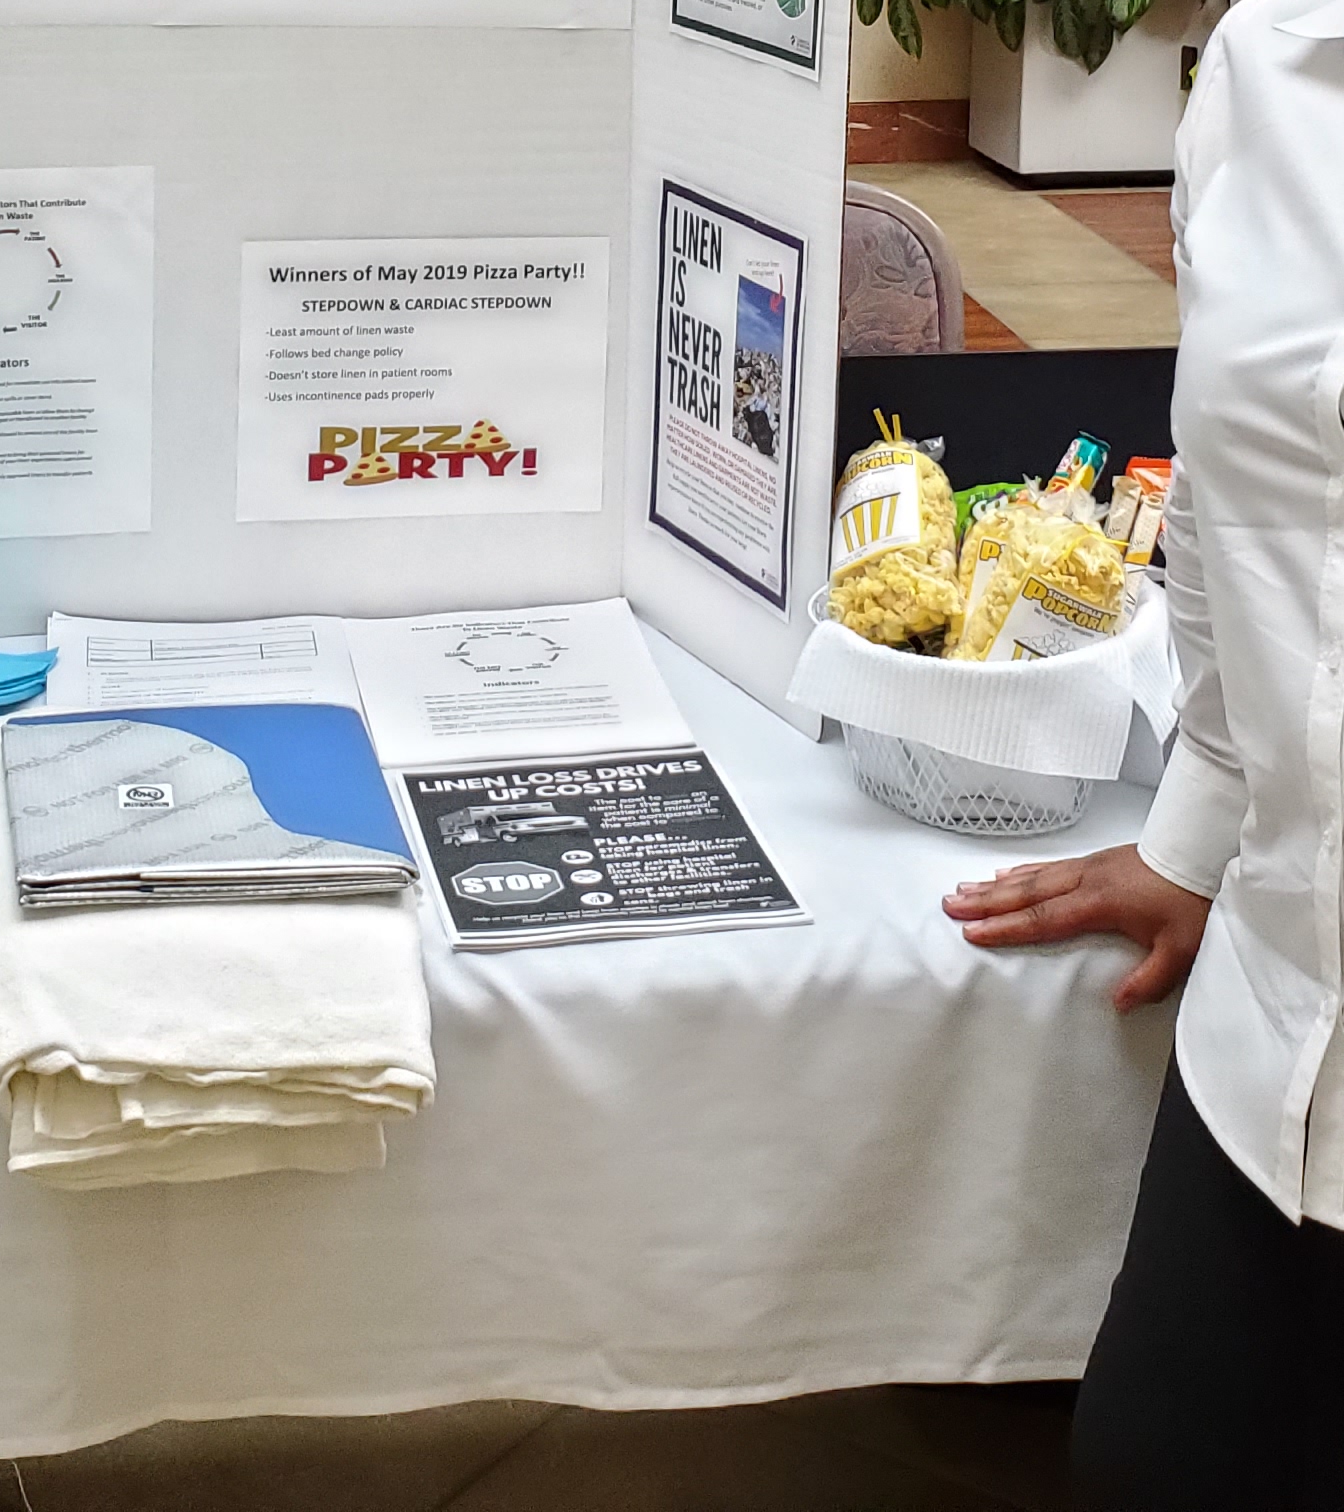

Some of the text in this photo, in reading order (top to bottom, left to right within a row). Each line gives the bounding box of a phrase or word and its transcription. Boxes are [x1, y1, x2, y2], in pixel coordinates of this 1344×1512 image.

[672, 205, 722, 274] LINEN
[269, 262, 585, 286] Winners of May 2019 Pizza Party!!
[669, 255, 687, 308] IS
[301, 296, 552, 313] STEPDOWN & CARDIAC STEPDOWN
[266, 325, 415, 337] -Least amount of linen waste
[668, 305, 722, 379] NEVER
[265, 346, 404, 360] -Follows bed change policy
[311, 370, 338, 380] store
[340, 368, 366, 379] linen
[369, 368, 379, 379] in
[381, 367, 417, 381] patient
[420, 368, 453, 378] rooms
[264, 388, 435, 402] -Uses incontinence pads properly
[667, 355, 722, 432] TRASH
[1022, 576, 1118, 634] POPCORN
[418, 759, 703, 793] LINEN LOSS DRIVES
[487, 777, 647, 802] UP COSTS!
[461, 872, 552, 894] STOP
